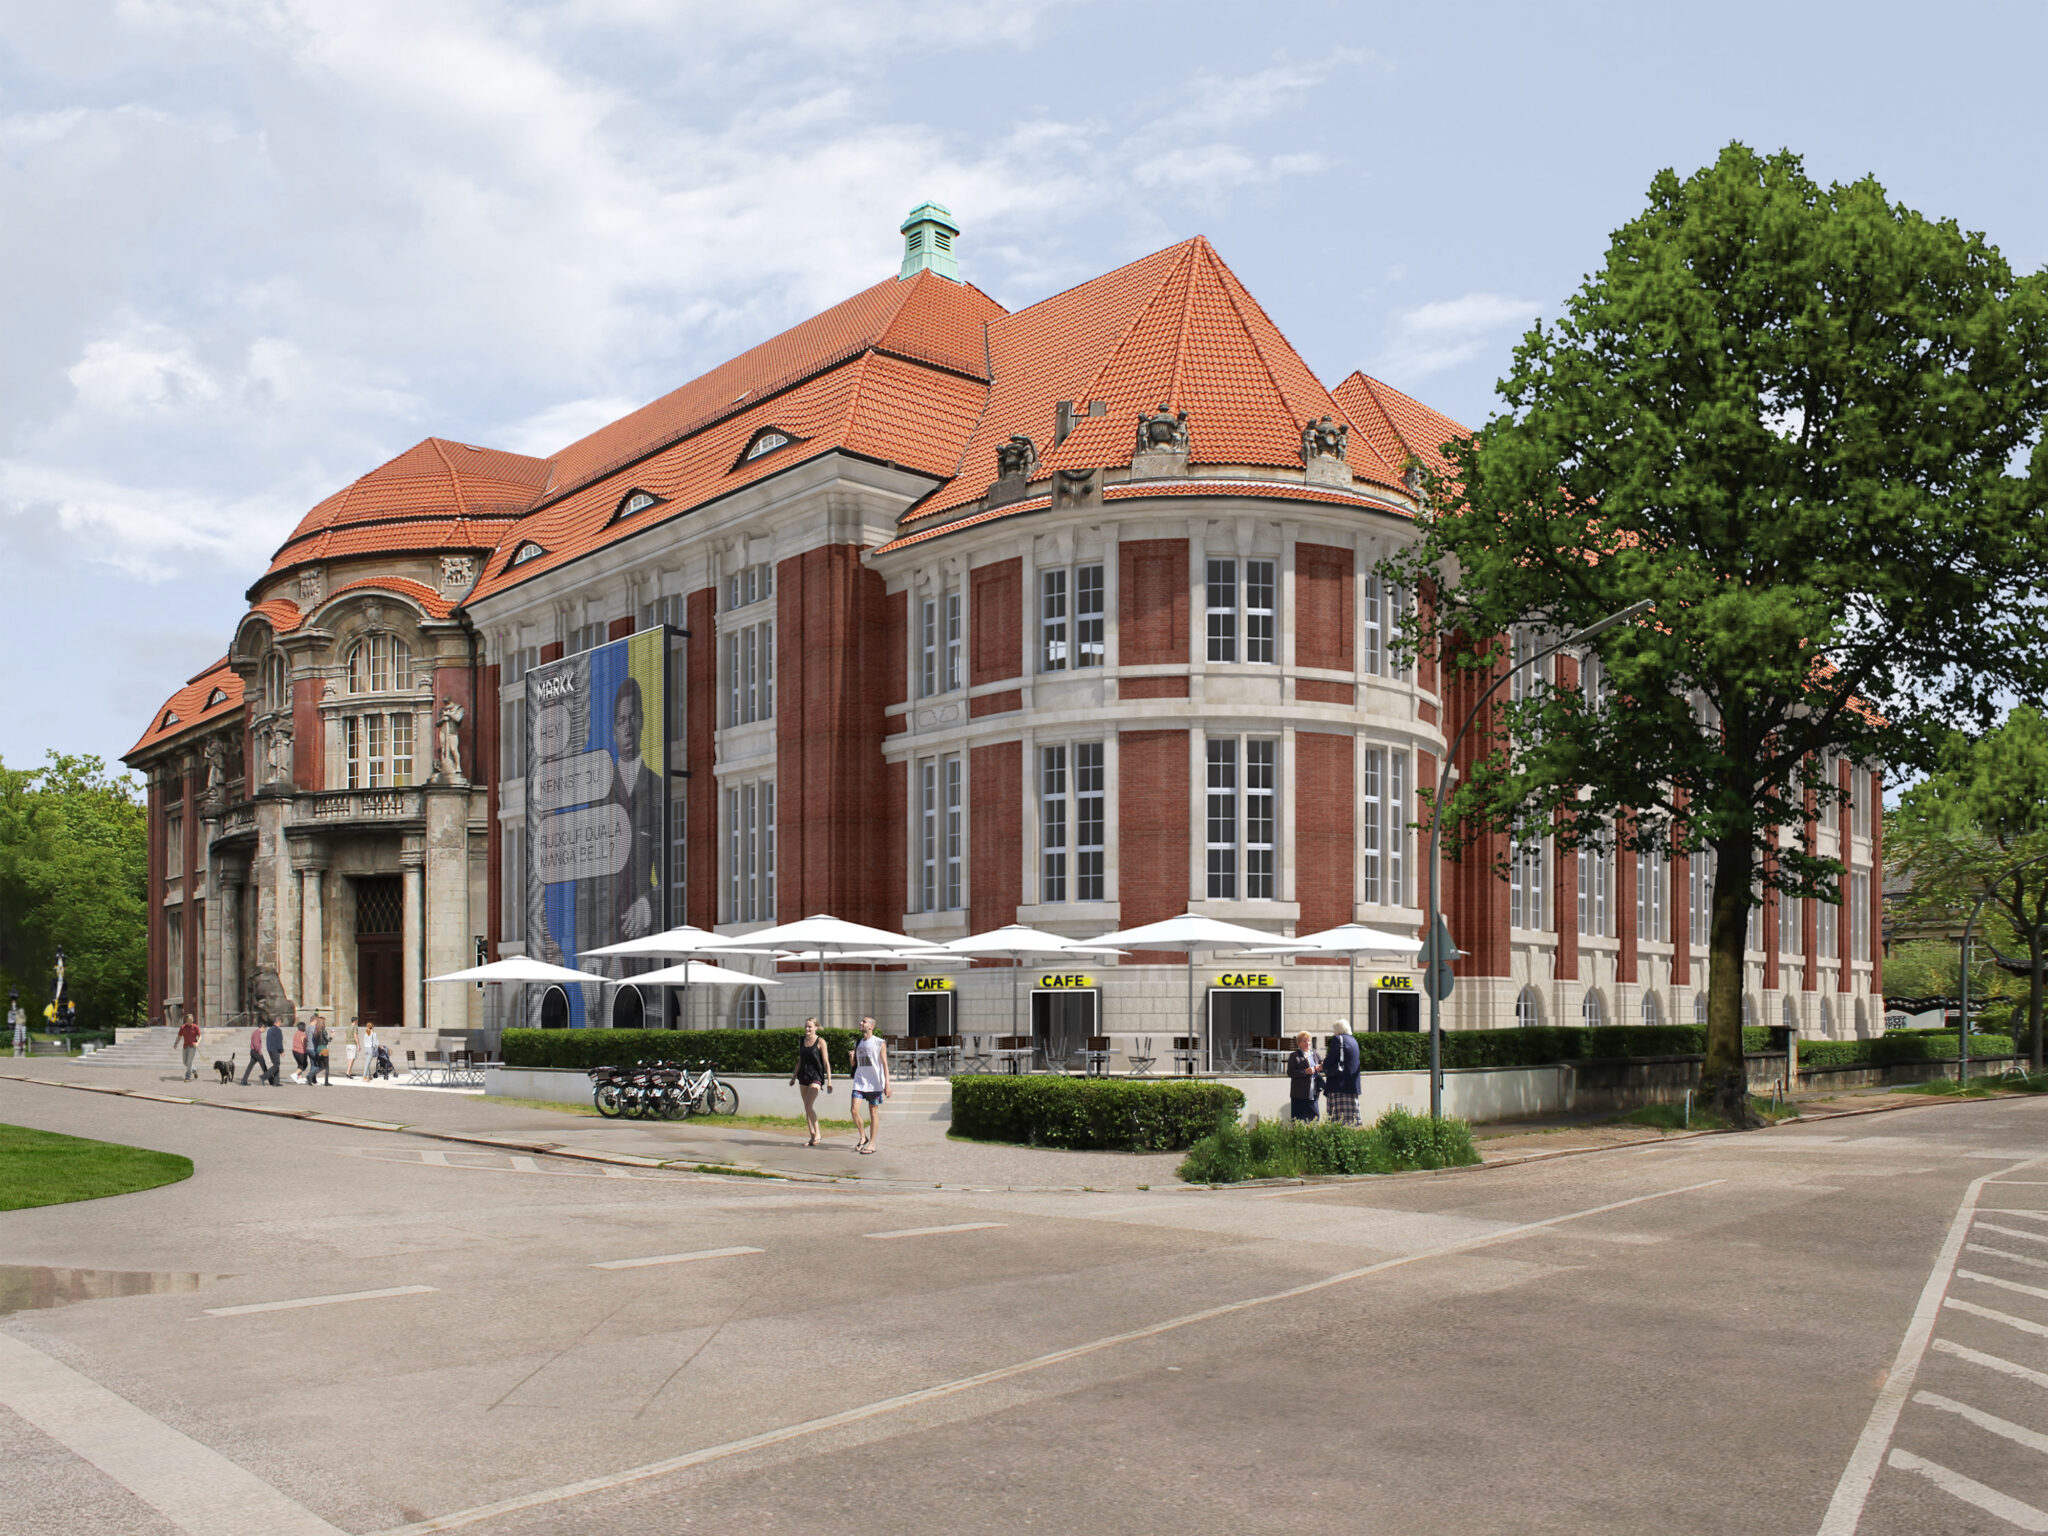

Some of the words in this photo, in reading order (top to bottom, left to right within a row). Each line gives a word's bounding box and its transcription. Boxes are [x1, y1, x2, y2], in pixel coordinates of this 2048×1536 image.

[537, 671, 575, 701] MARKK
[540, 721, 561, 742] HEY
[540, 772, 581, 795] KENNST
[540, 828, 581, 850] RUDOLF
[585, 822, 622, 843] DUALA
[540, 849, 576, 868] MANGA
[580, 842, 615, 862] BELL?
[915, 977, 944, 990] CAFE
[1041, 974, 1085, 987] CAFE
[1221, 973, 1268, 987] CAFE
[1381, 975, 1410, 988] CAFE
